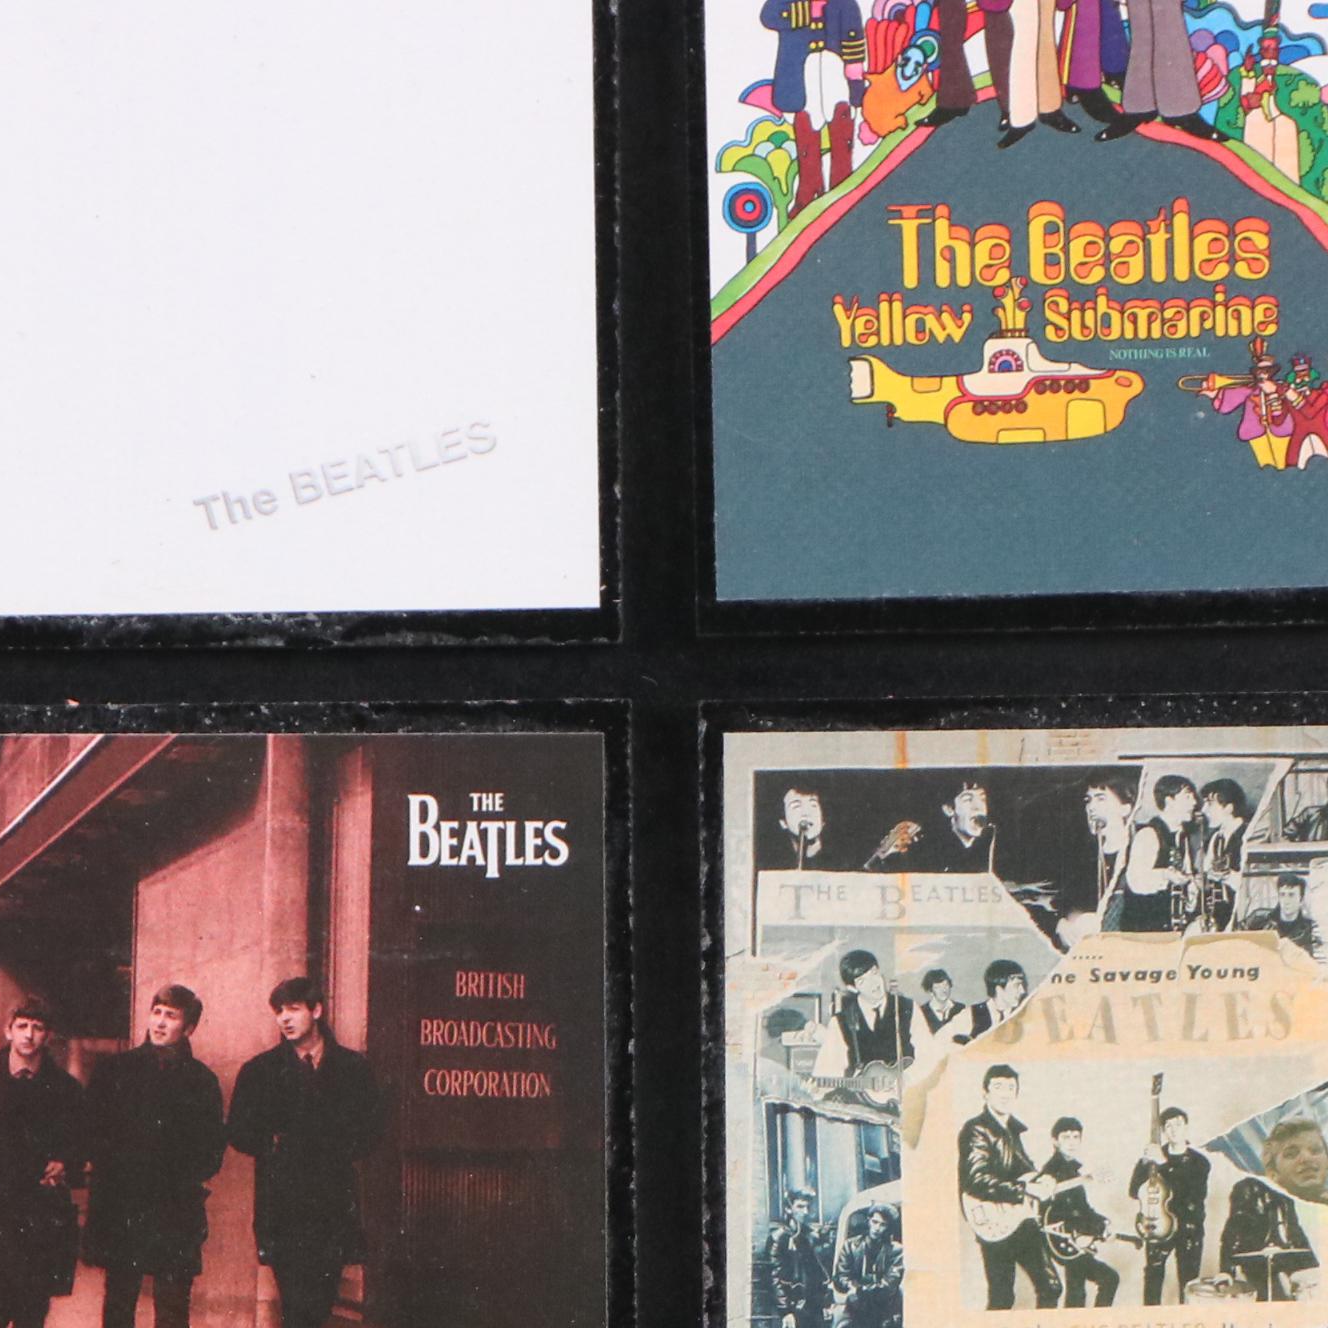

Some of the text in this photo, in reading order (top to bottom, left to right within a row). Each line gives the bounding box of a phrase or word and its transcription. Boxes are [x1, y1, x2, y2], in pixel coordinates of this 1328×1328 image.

[886, 196, 1271, 289] The Beatles
[832, 283, 1280, 348] Yellow Submarine
[1109, 347, 1164, 360] NOTHING
[192, 421, 498, 531] The BEATLES
[469, 792, 504, 812] THE
[407, 793, 570, 878] BEATLES
[455, 970, 525, 999] BRITISH
[1089, 967, 1178, 985] Savage
[1186, 963, 1261, 982] Young
[420, 1018, 557, 1050] BROADCASTING
[424, 1068, 551, 1098] CORPORATION
